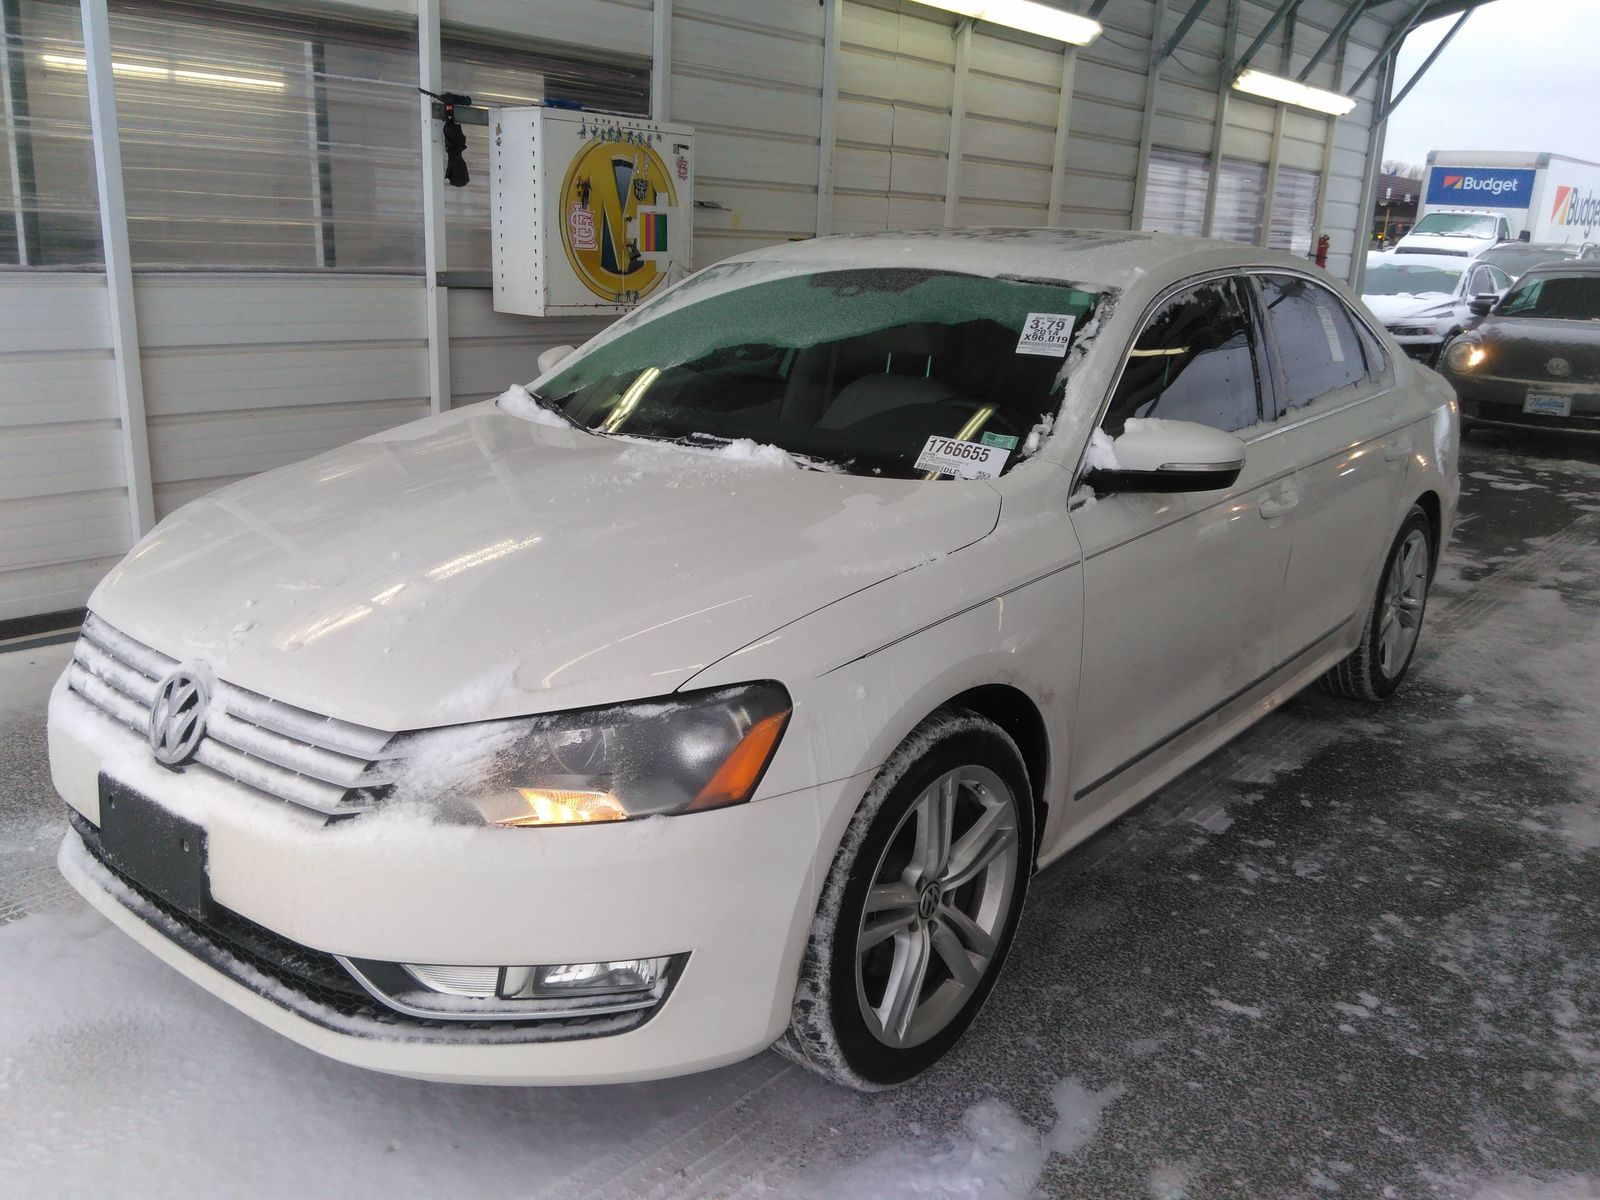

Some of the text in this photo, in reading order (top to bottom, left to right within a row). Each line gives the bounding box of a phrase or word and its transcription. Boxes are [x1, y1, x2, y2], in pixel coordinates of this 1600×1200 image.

[1463, 176, 1518, 195] Budget
[1566, 187, 1600, 239] Budge
[1033, 328, 1059, 336] 2014
[928, 439, 991, 462] 1766655
